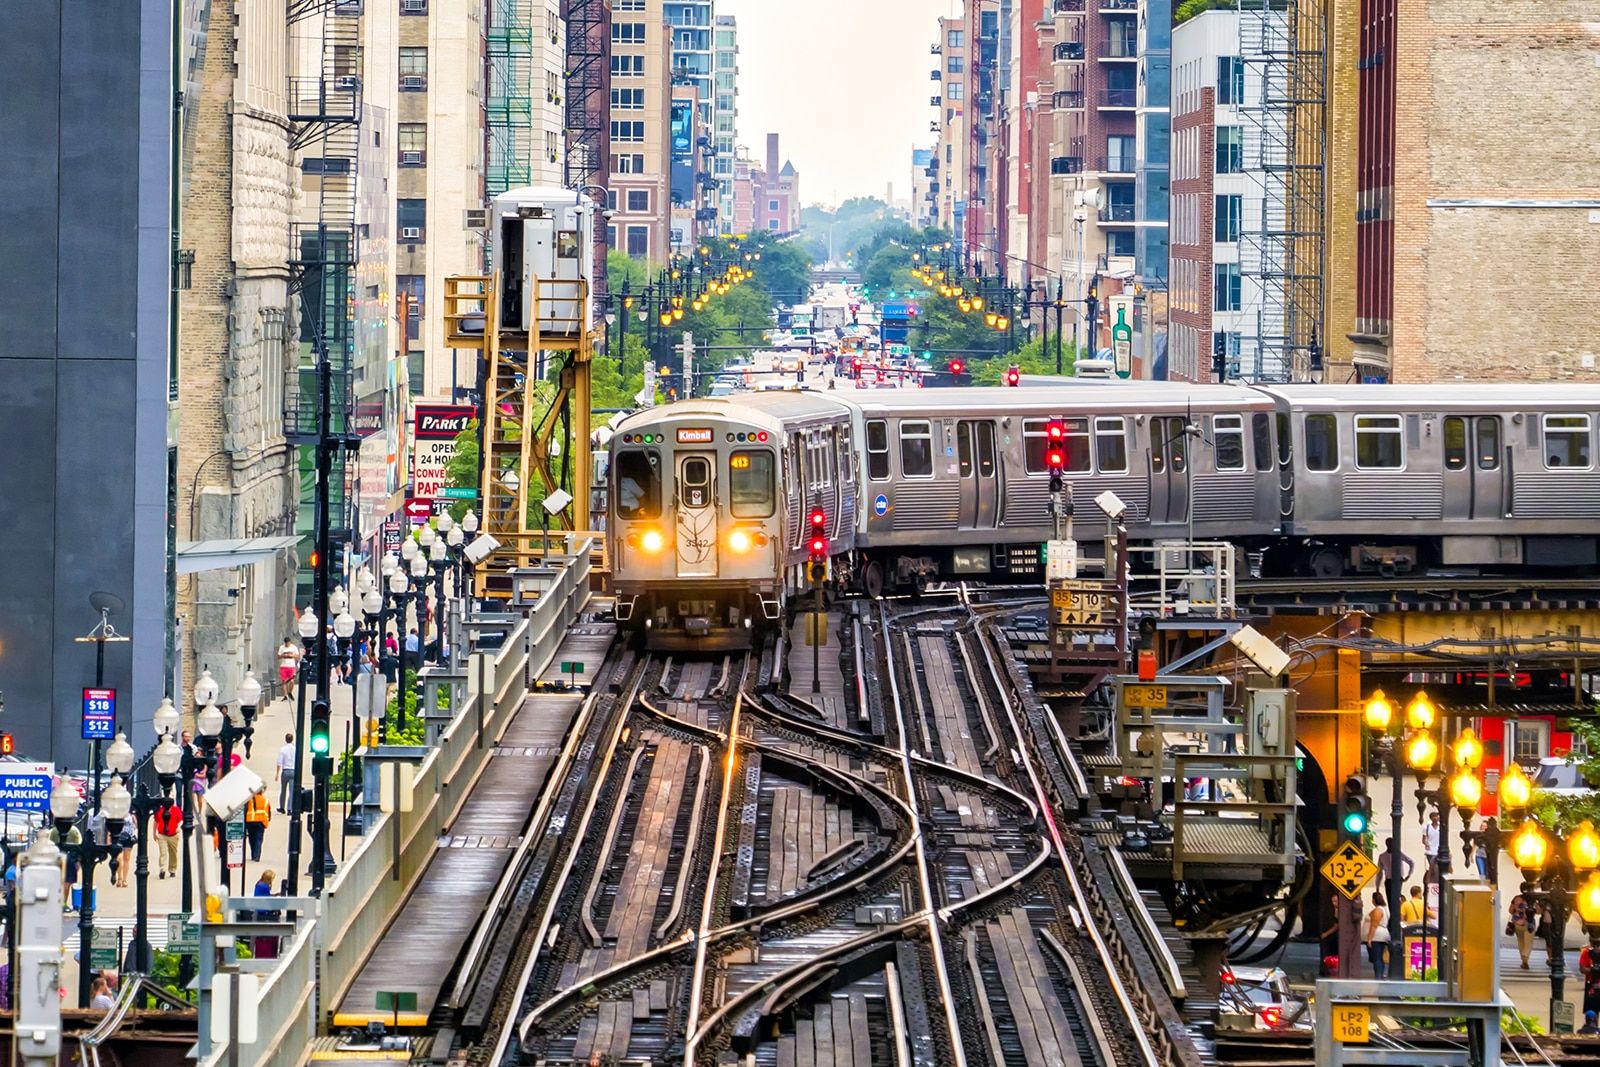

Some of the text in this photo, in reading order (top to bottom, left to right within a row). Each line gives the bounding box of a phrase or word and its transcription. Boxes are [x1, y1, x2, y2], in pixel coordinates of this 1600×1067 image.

[421, 416, 468, 430] PARK 1
[679, 431, 711, 441] Kimball
[431, 443, 457, 453] OPEN
[421, 454, 432, 464] 24
[731, 455, 749, 468] 413
[1055, 591, 1069, 602] 35
[1085, 593, 1099, 606] 10
[1147, 688, 1164, 701] 35
[89, 700, 110, 711] $18
[89, 720, 109, 731] $12
[3, 736, 11, 753] 6
[5, 778, 44, 788] PUBLIC
[0, 789, 49, 799] PARKING
[1340, 1011, 1363, 1023] LP2
[1341, 1026, 1362, 1037] 108
